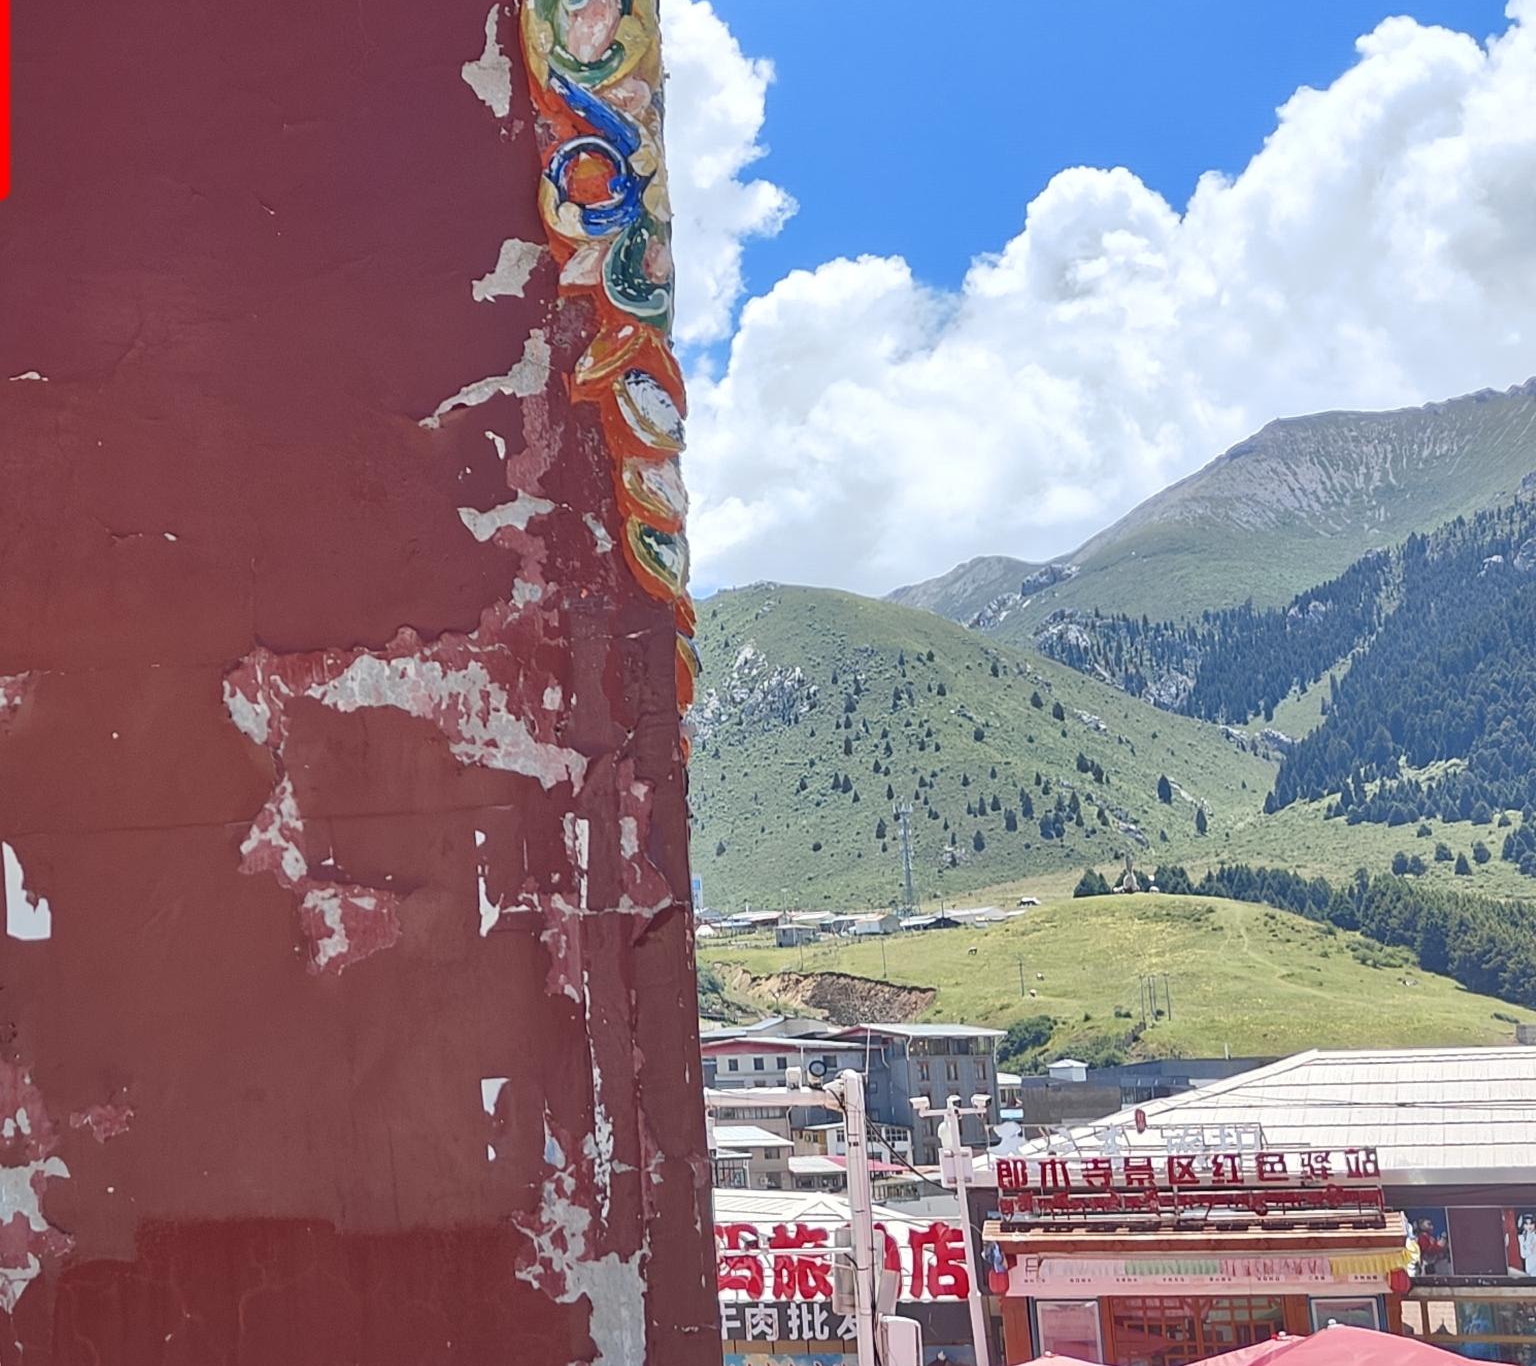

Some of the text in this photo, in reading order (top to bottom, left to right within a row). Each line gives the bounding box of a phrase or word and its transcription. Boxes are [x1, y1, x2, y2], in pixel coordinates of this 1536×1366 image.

[995, 1146, 1381, 1191] 郎木寺景区红色驿站
